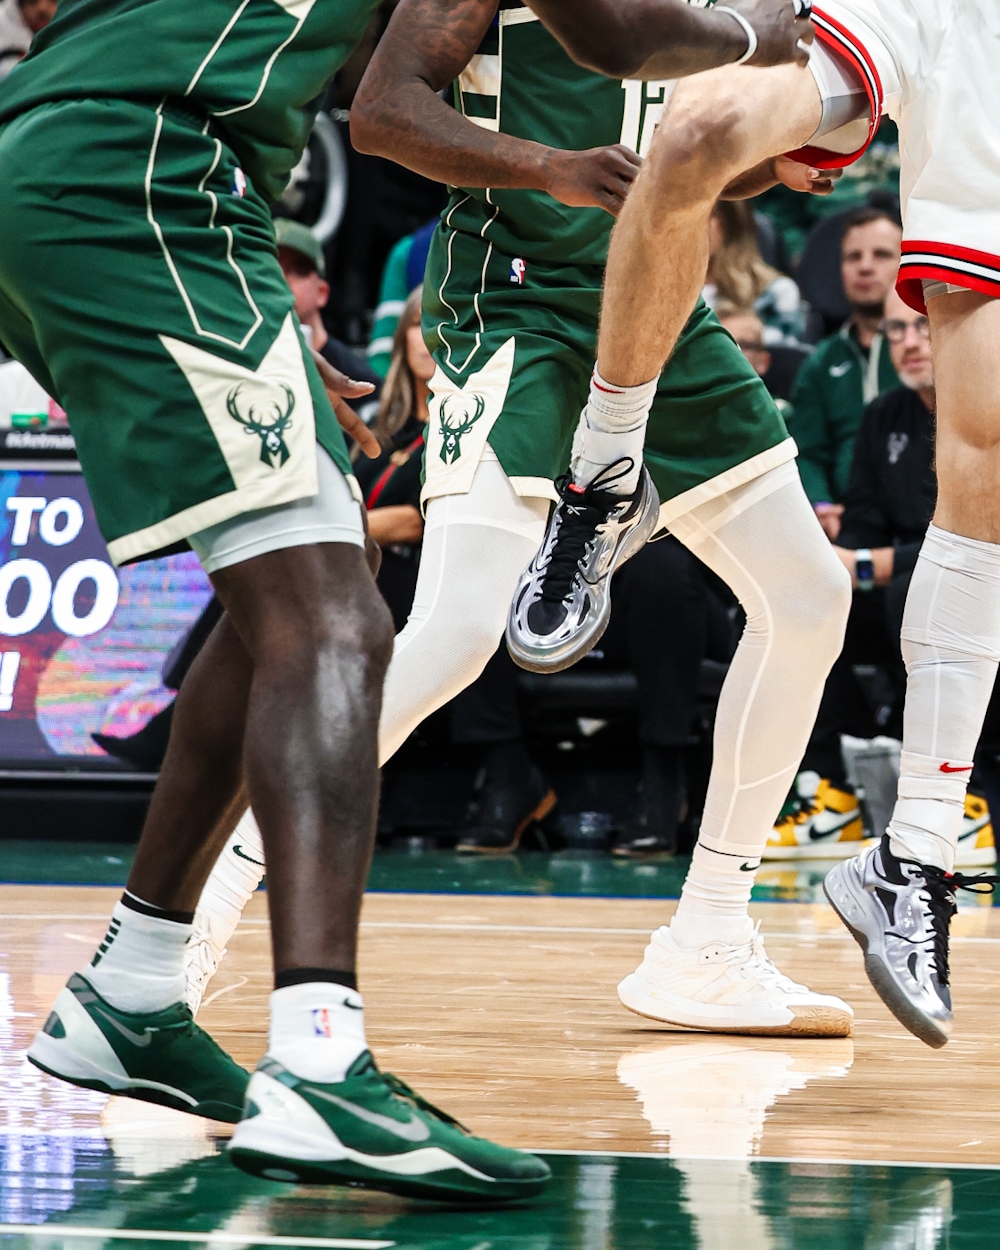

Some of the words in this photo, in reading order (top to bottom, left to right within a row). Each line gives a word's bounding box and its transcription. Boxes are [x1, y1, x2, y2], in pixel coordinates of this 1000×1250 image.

[619, 78, 678, 159] 12
[5, 431, 76, 450] ticketma
[6, 497, 84, 547] TO
